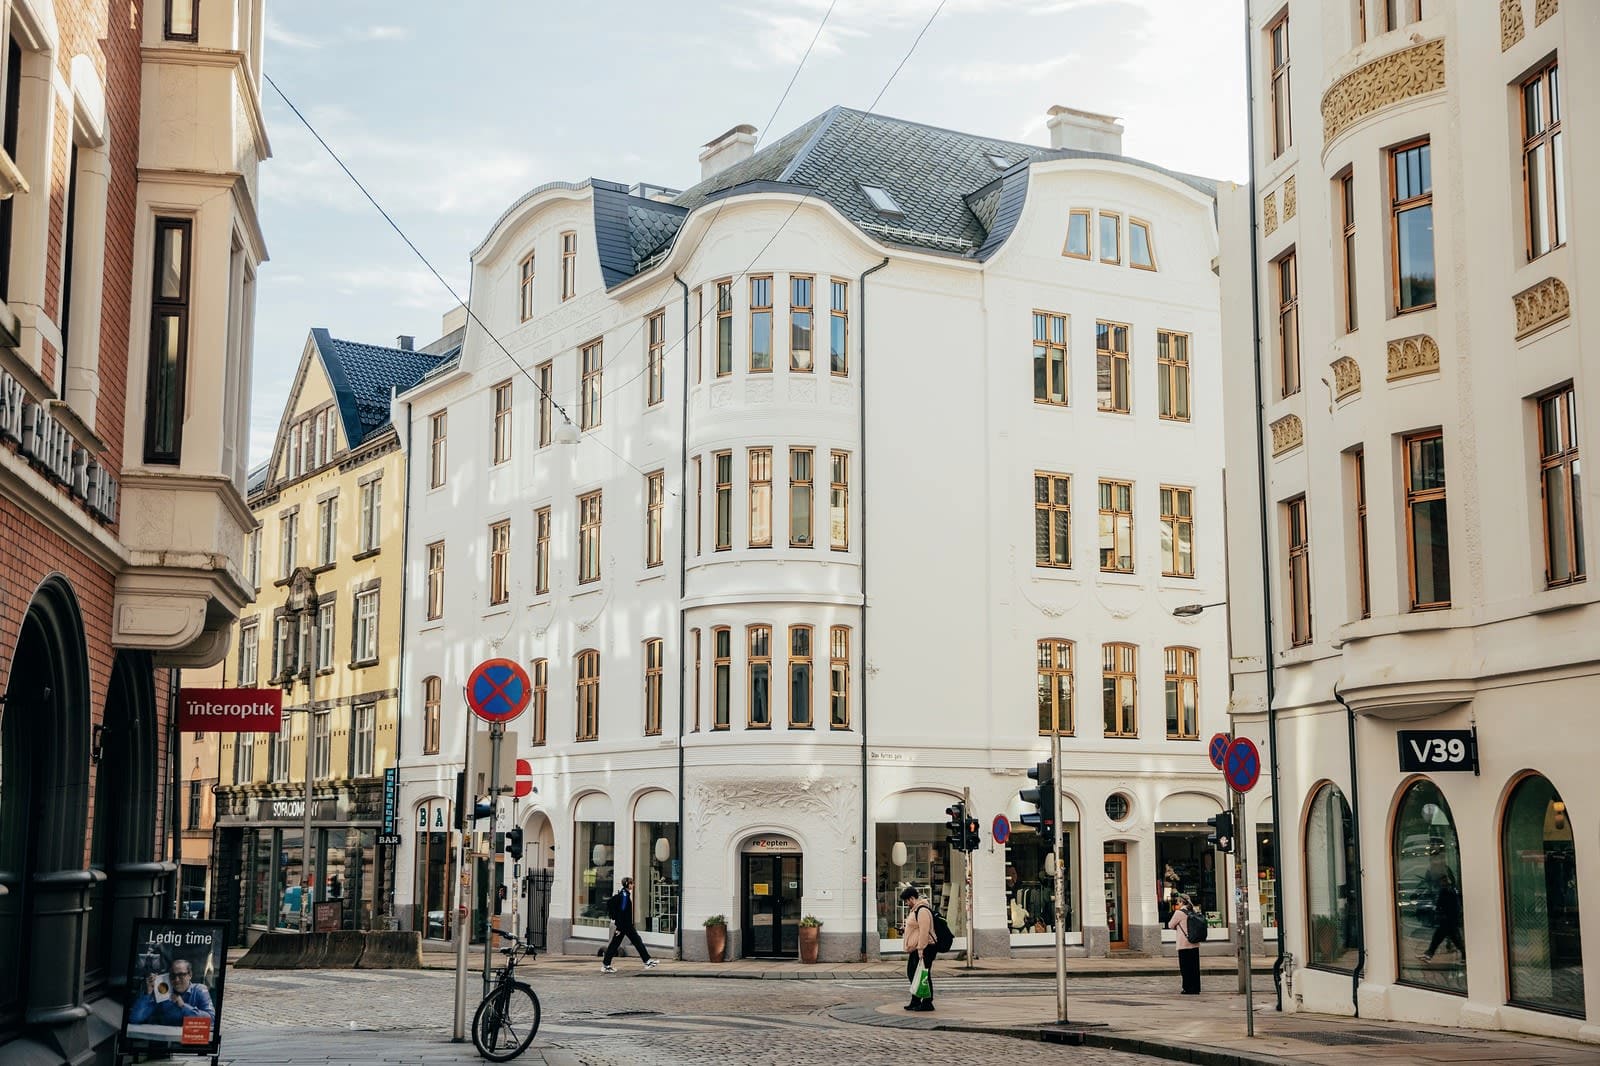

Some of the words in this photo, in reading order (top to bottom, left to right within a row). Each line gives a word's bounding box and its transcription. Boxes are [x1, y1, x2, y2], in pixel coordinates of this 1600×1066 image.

[0, 365, 26, 444] SK
[32, 403, 75, 488] GRILL
[95, 462, 118, 524] BAR
[1409, 738, 1466, 763] V39
[378, 836, 398, 844] BAR
[149, 930, 182, 947] Ledig
[186, 931, 212, 945] time
